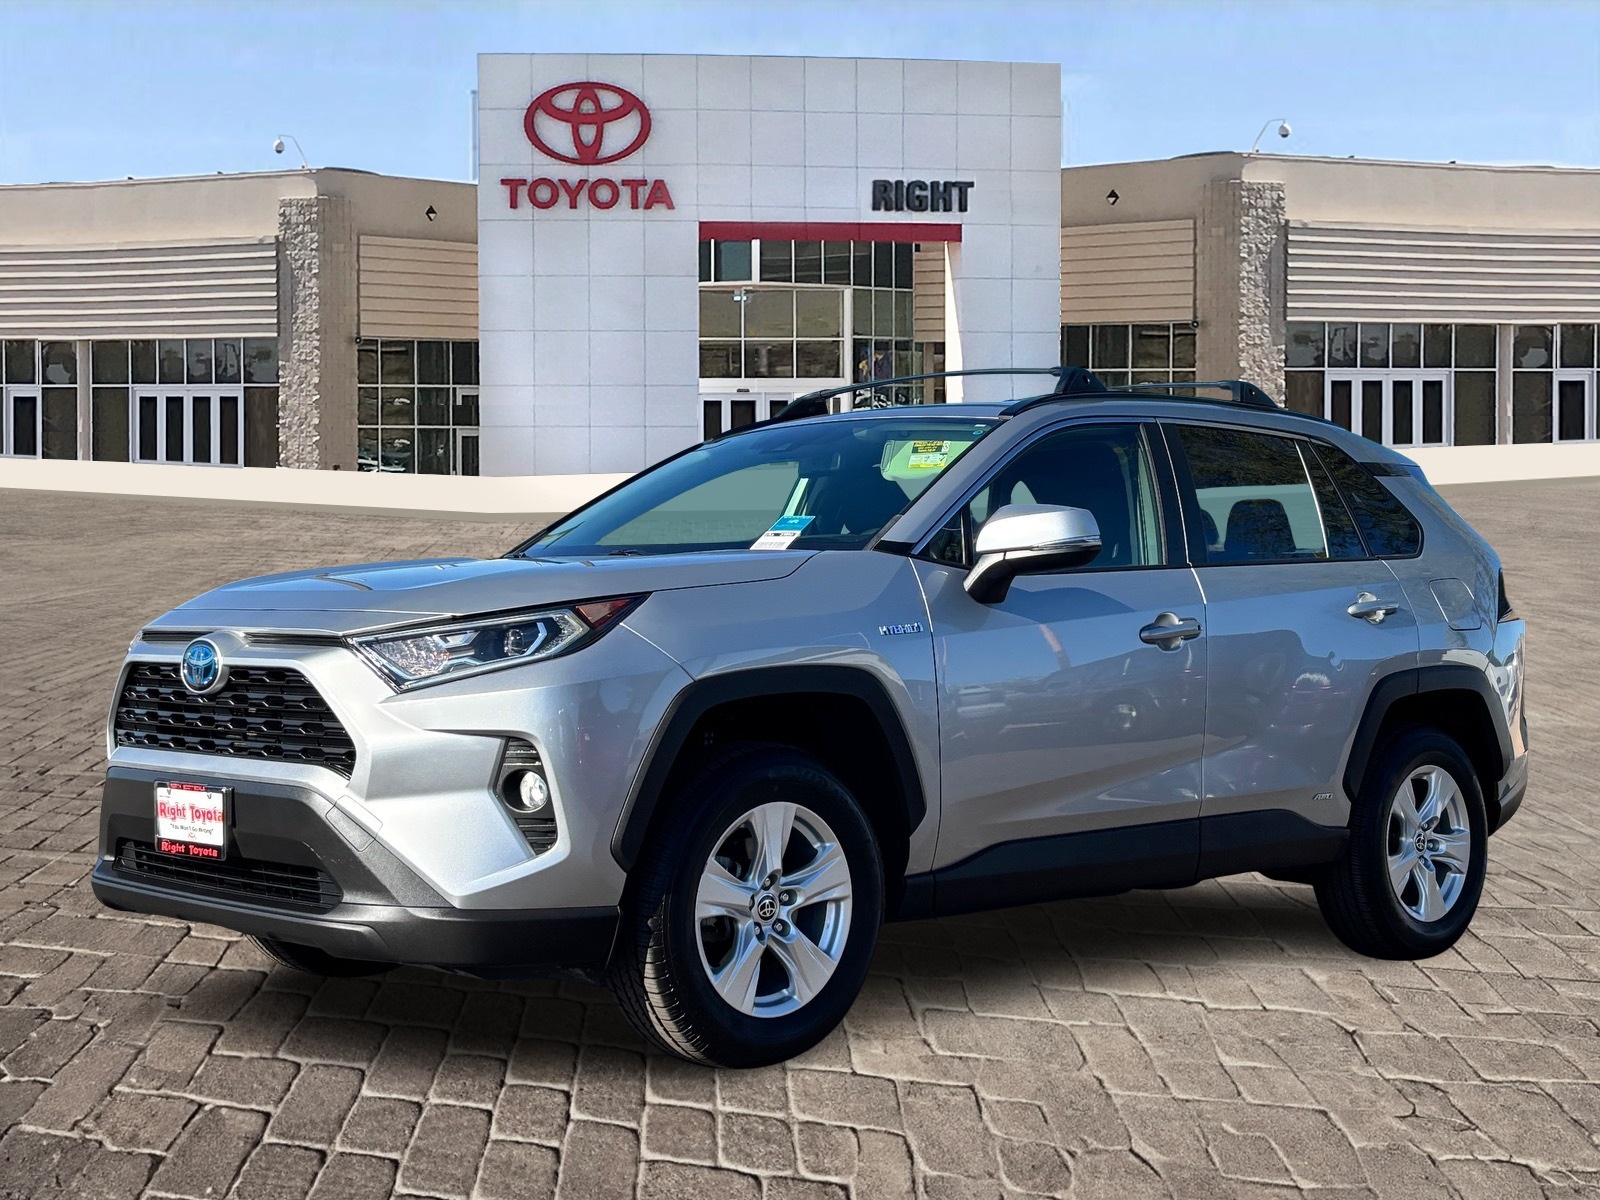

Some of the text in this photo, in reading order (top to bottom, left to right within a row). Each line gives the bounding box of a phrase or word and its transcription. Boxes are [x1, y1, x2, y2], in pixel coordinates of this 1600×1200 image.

[500, 177, 675, 210] TOYOTA
[871, 179, 975, 213] RIGHT
[158, 801, 224, 823] Right Toyota
[161, 841, 218, 857] Right Toyota
